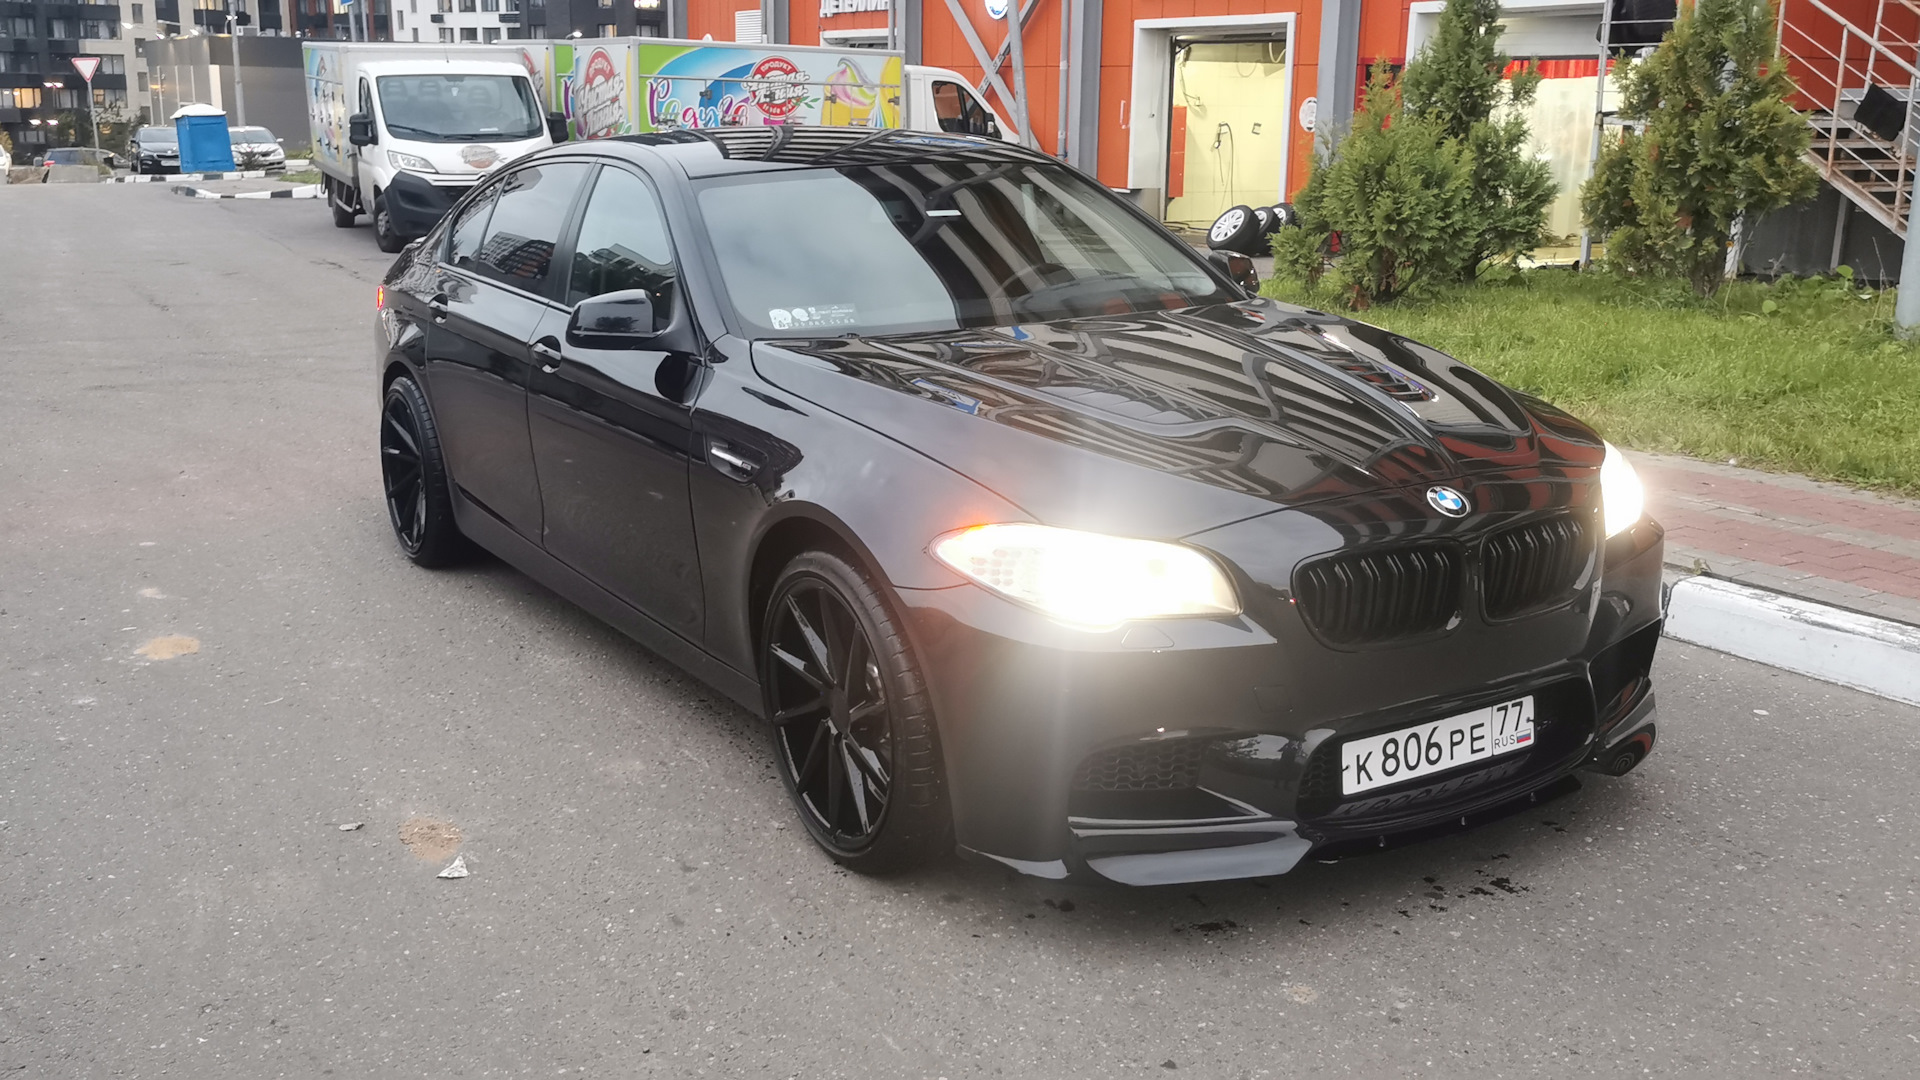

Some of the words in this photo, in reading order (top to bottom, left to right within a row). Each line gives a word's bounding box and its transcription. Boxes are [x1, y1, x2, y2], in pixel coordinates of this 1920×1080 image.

[1356, 722, 1486, 785] К806РЕ
[1496, 700, 1524, 736] 77
[1494, 734, 1516, 749] RUS
